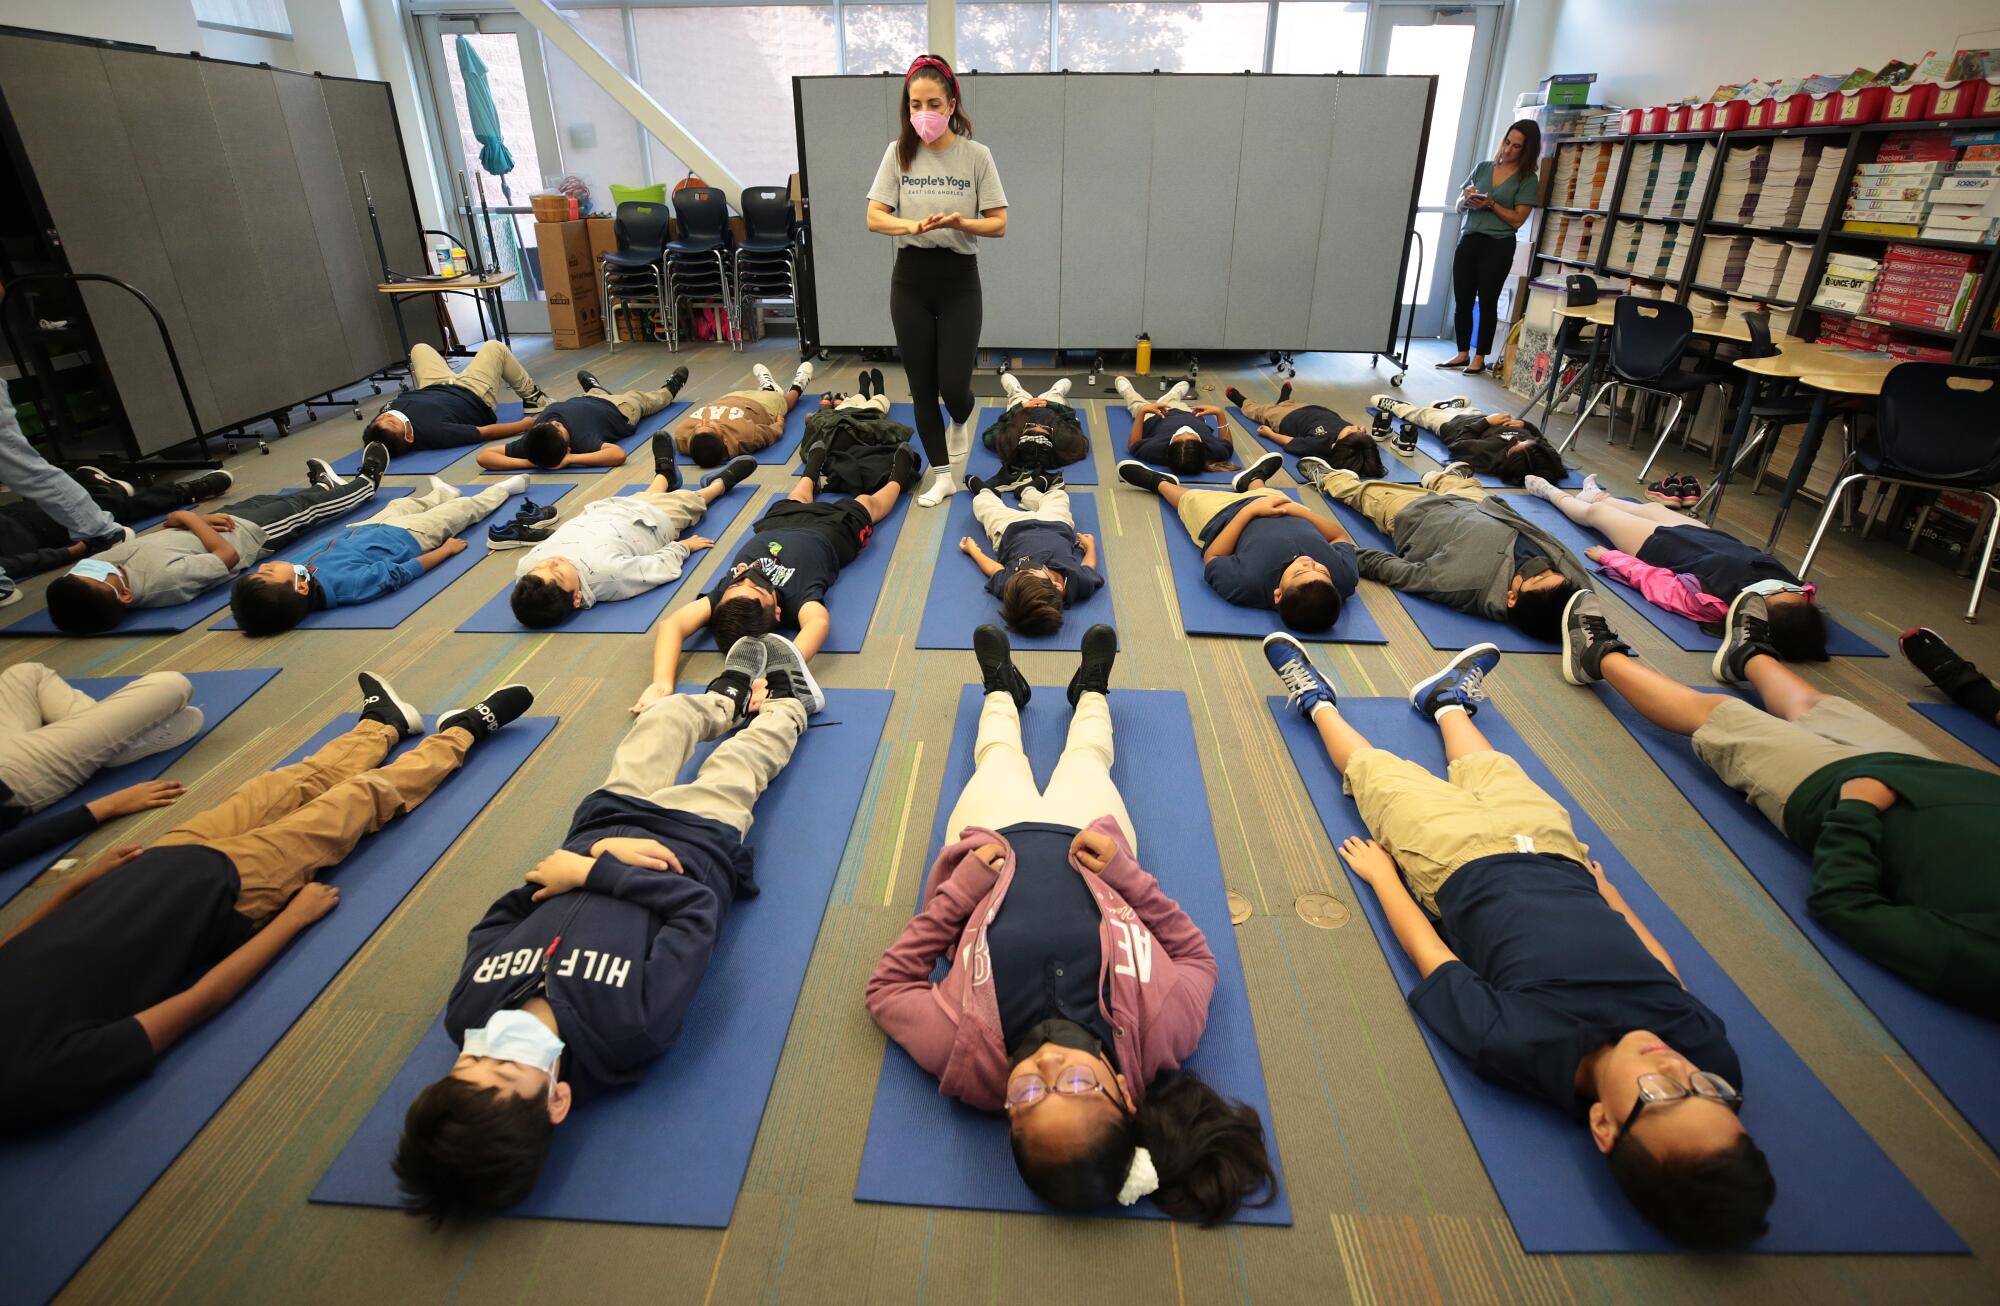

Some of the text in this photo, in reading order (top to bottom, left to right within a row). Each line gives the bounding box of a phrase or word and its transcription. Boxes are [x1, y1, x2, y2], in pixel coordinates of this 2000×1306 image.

[1815, 103, 1823, 117] 2
[1846, 101, 1854, 114] 2
[1893, 98, 1903, 115] 3
[901, 175, 971, 190] People's Yoga
[1825, 277, 1864, 288] BOUNCE-OFF
